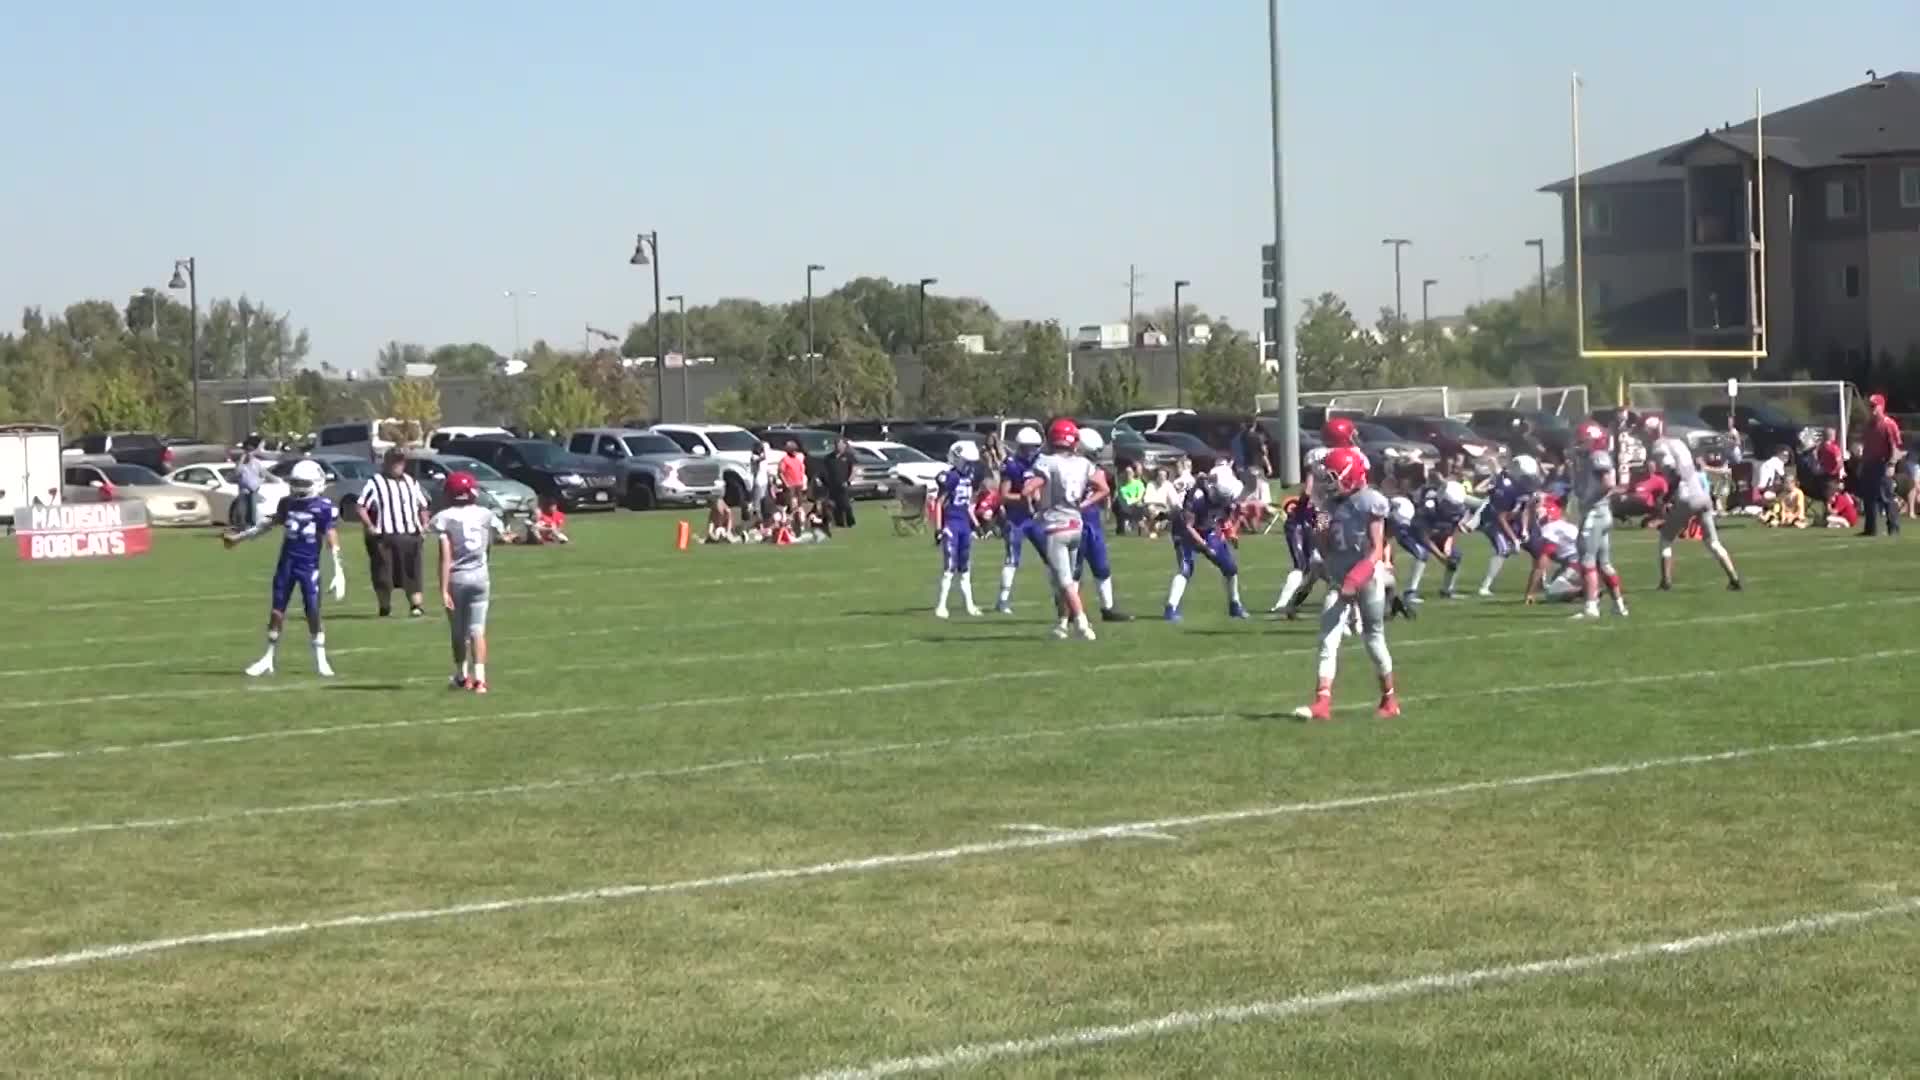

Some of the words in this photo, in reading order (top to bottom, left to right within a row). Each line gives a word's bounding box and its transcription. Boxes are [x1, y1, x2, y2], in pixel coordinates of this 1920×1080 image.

[32, 504, 121, 530] MADISON
[31, 531, 125, 559] BOBCATS
[463, 519, 484, 551] 5
